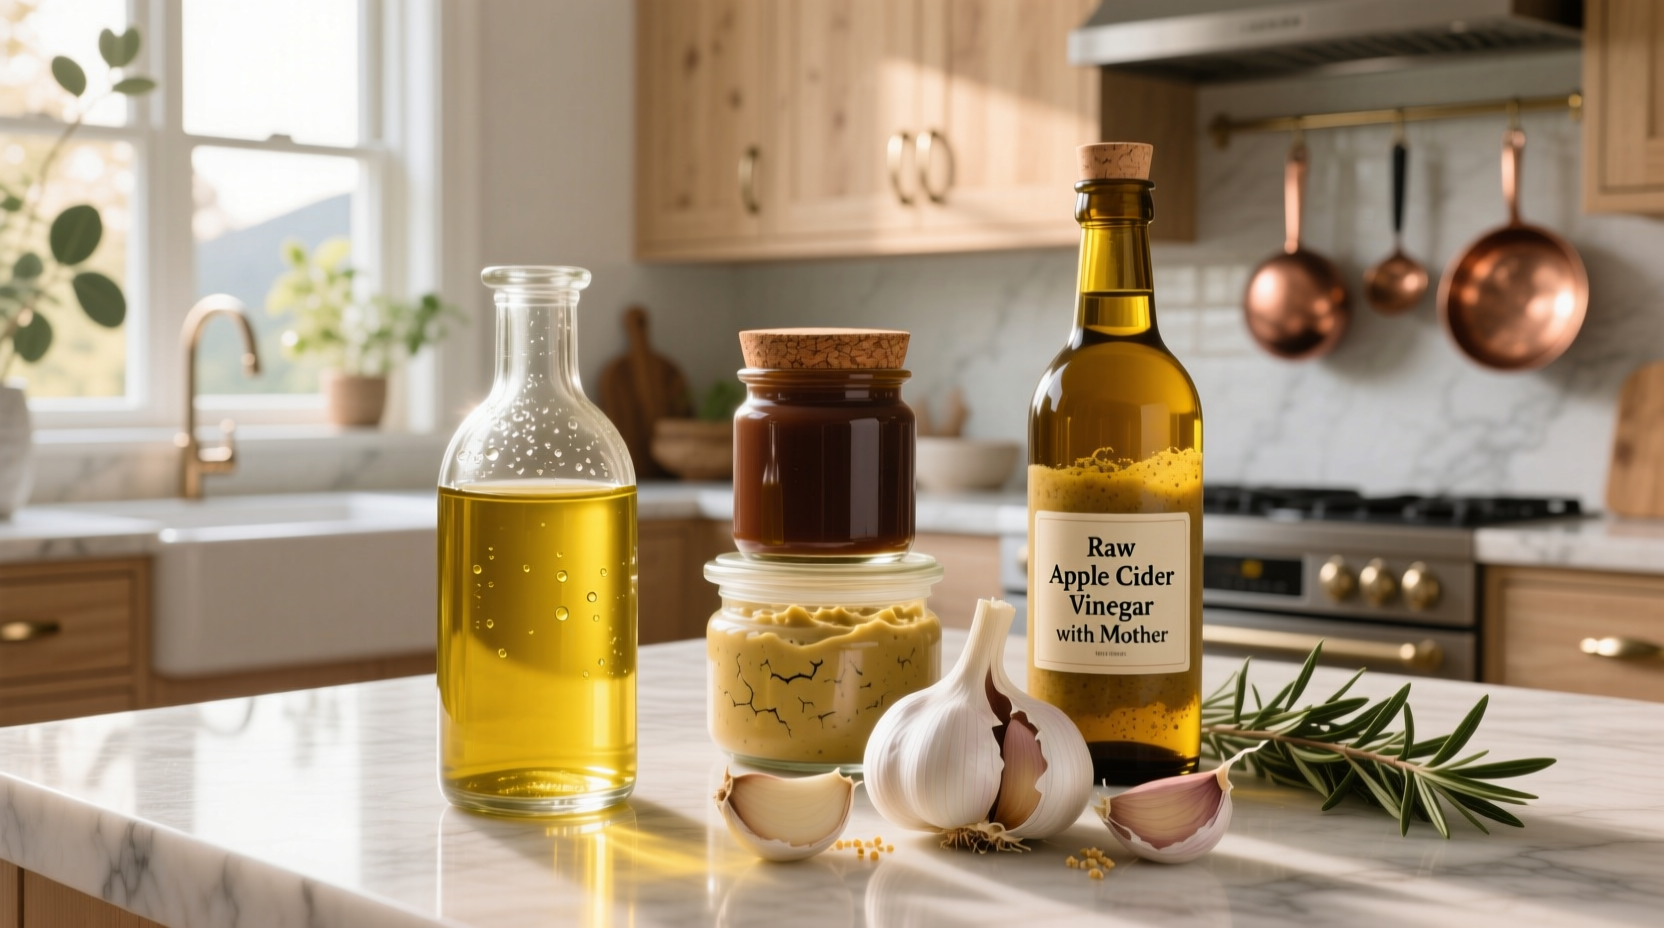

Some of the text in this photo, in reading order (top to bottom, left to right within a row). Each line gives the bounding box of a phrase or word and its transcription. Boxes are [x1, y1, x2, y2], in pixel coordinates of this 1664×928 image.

[1086, 536, 1136, 558] Raw
[1048, 564, 1175, 592] Apple Cider
[1069, 594, 1154, 622] Vinegar
[1056, 624, 1169, 644] with Mother
